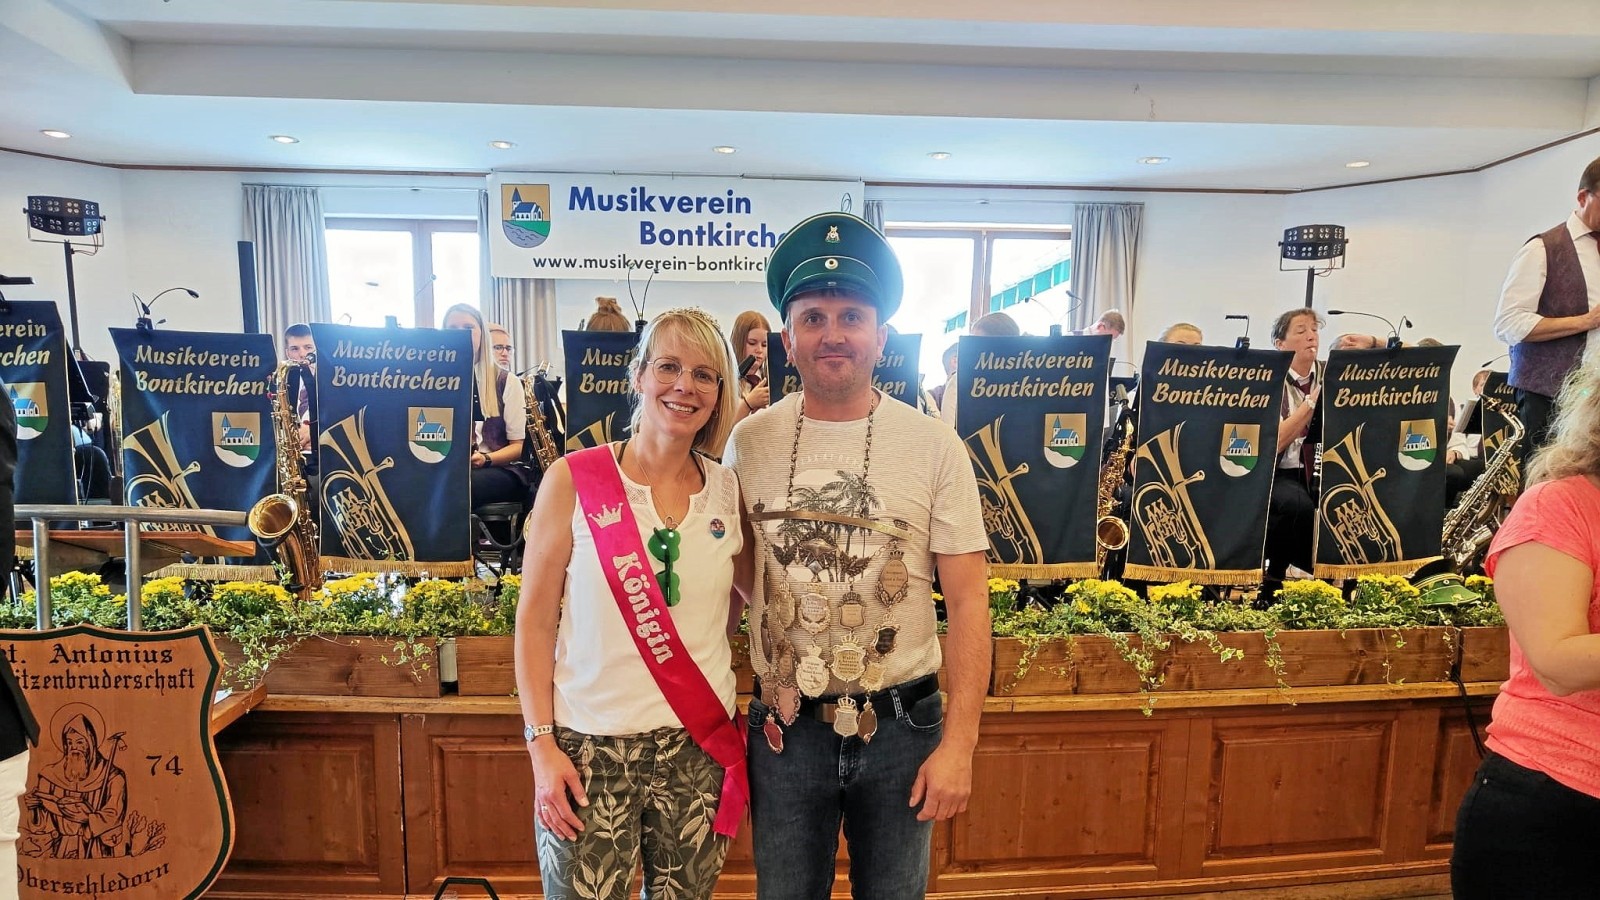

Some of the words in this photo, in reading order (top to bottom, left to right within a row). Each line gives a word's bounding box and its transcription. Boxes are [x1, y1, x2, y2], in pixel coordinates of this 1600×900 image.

[568, 186, 751, 214] Musikverein
[134, 345, 260, 368] Musikverein
[333, 340, 457, 363] Musikverein
[974, 350, 1094, 370] Musikverein
[332, 366, 461, 391] Bontkirchen
[1158, 358, 1273, 382] Musikverein
[1338, 362, 1440, 382] Musikverein
[135, 370, 265, 396] Bontkirchen
[970, 375, 1095, 398] Bontkirchen
[1334, 380, 1439, 408] Bontkirchen
[1152, 382, 1270, 408] Bontkirchen
[612, 551, 673, 665] Königin
[49, 643, 173, 664] Antonius
[146, 755, 183, 776] 74
